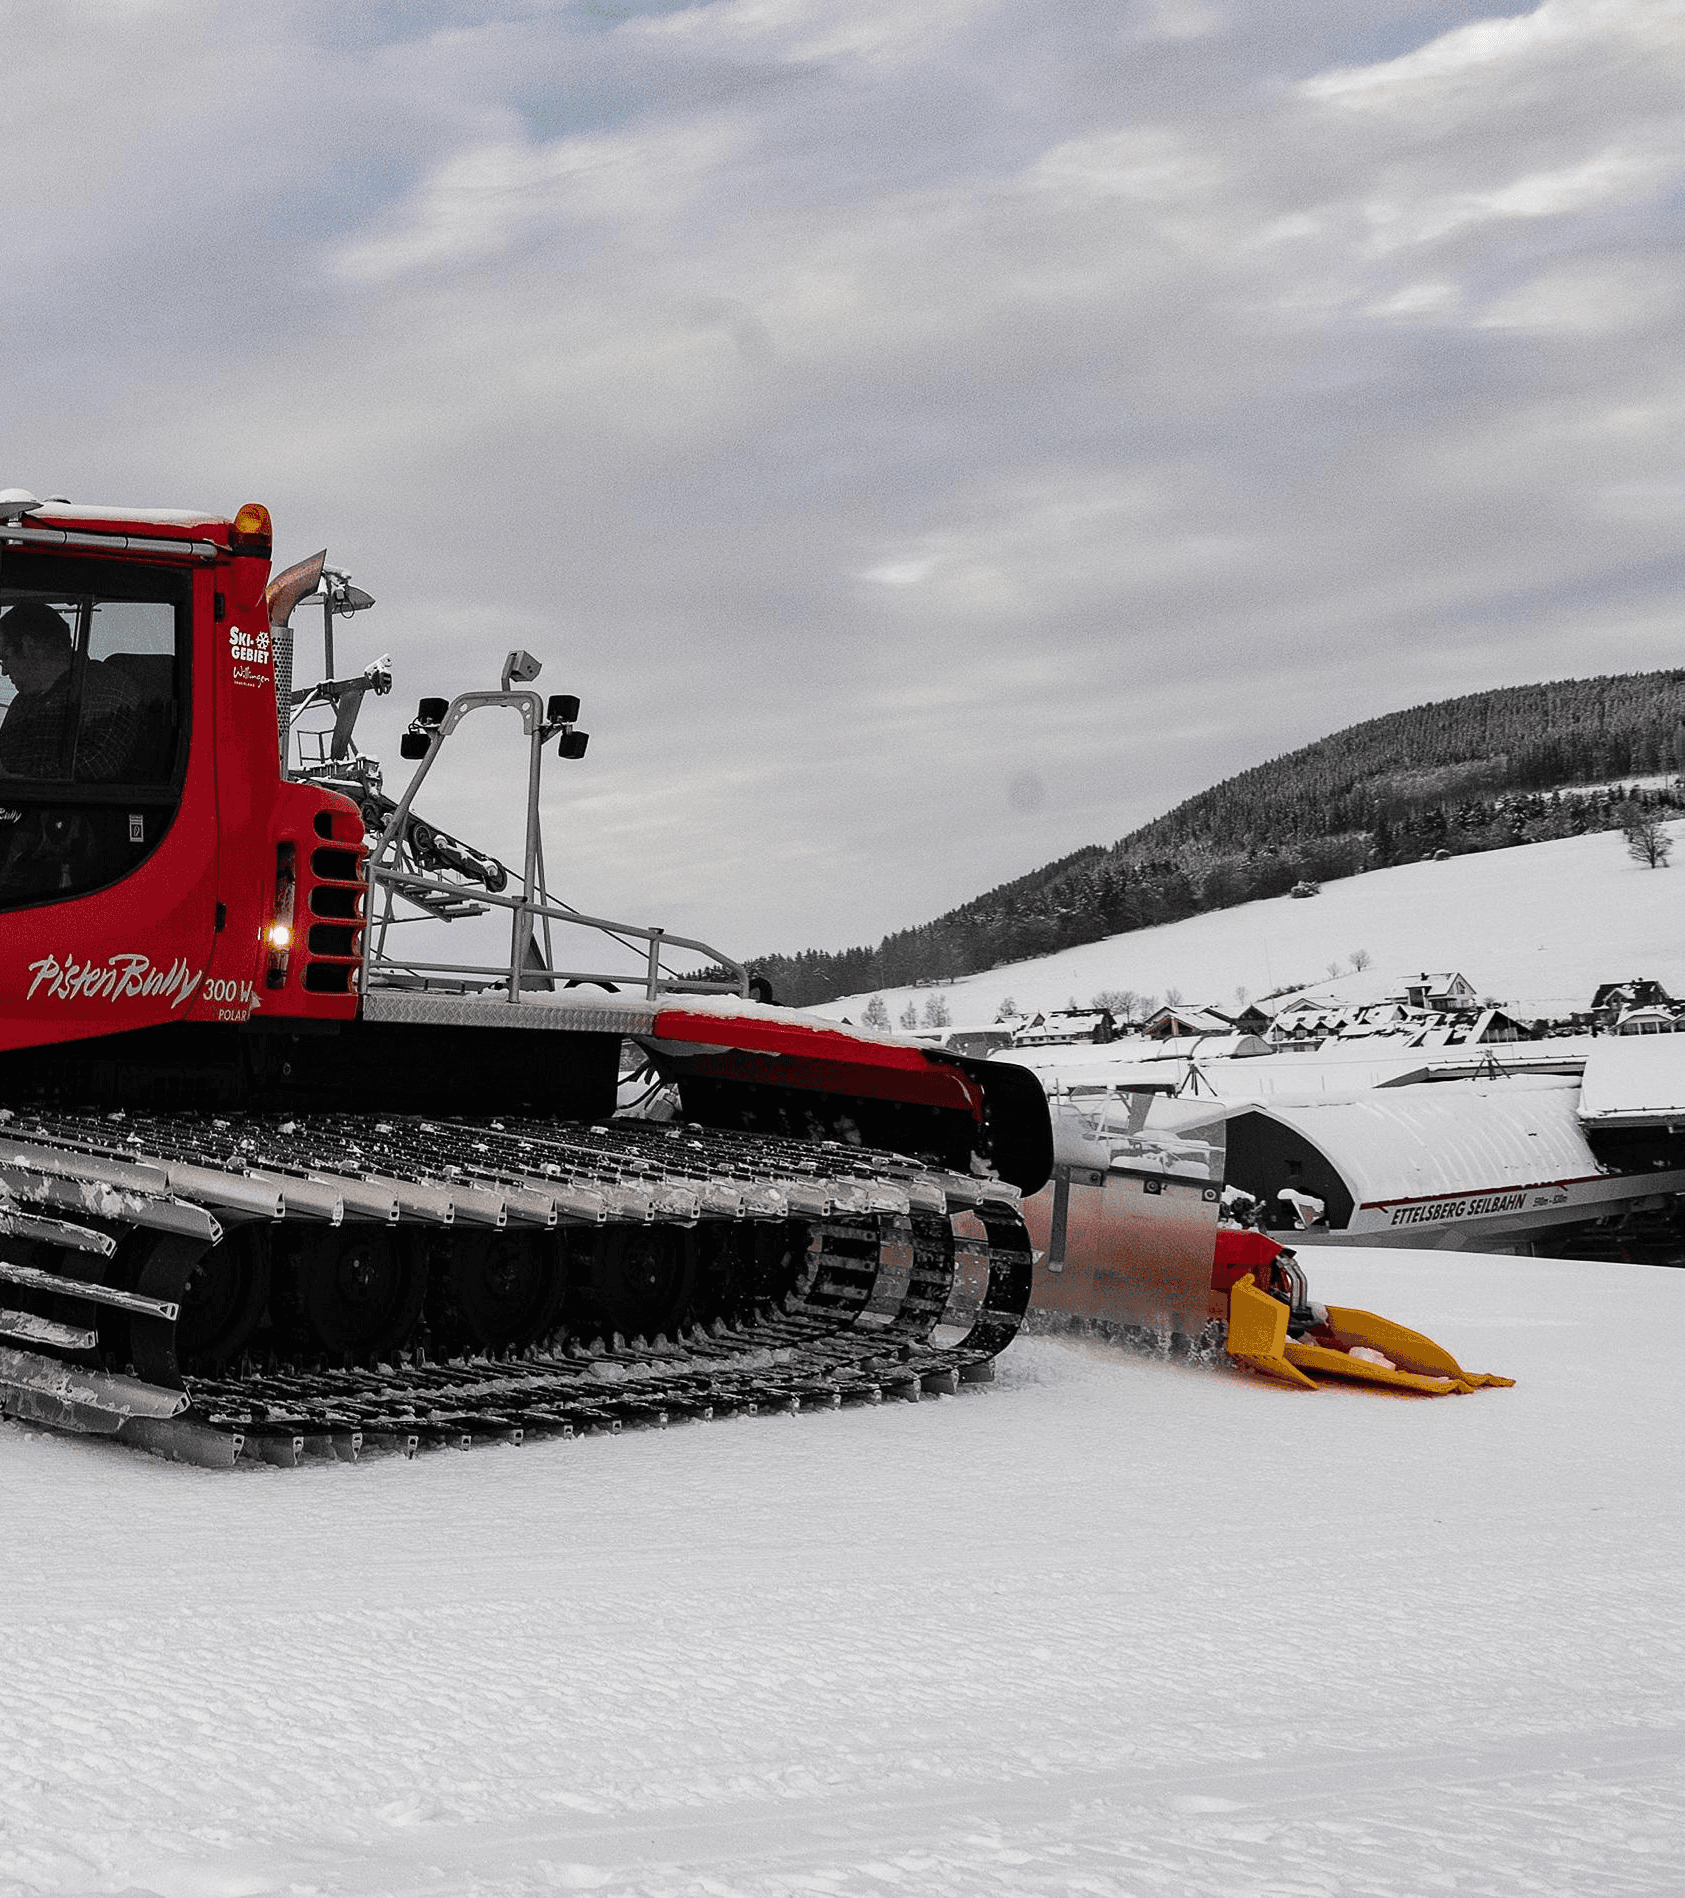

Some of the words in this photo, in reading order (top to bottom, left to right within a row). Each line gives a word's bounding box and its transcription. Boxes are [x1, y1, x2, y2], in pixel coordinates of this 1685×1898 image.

[231, 646, 269, 664] GEBIET
[27, 953, 203, 1009] PistenBully
[203, 979, 237, 1002] 300
[218, 1008, 247, 1021] POLAR
[1391, 1201, 1466, 1225] ETTELSBERG
[1467, 1194, 1527, 1216] SEILBAHN
